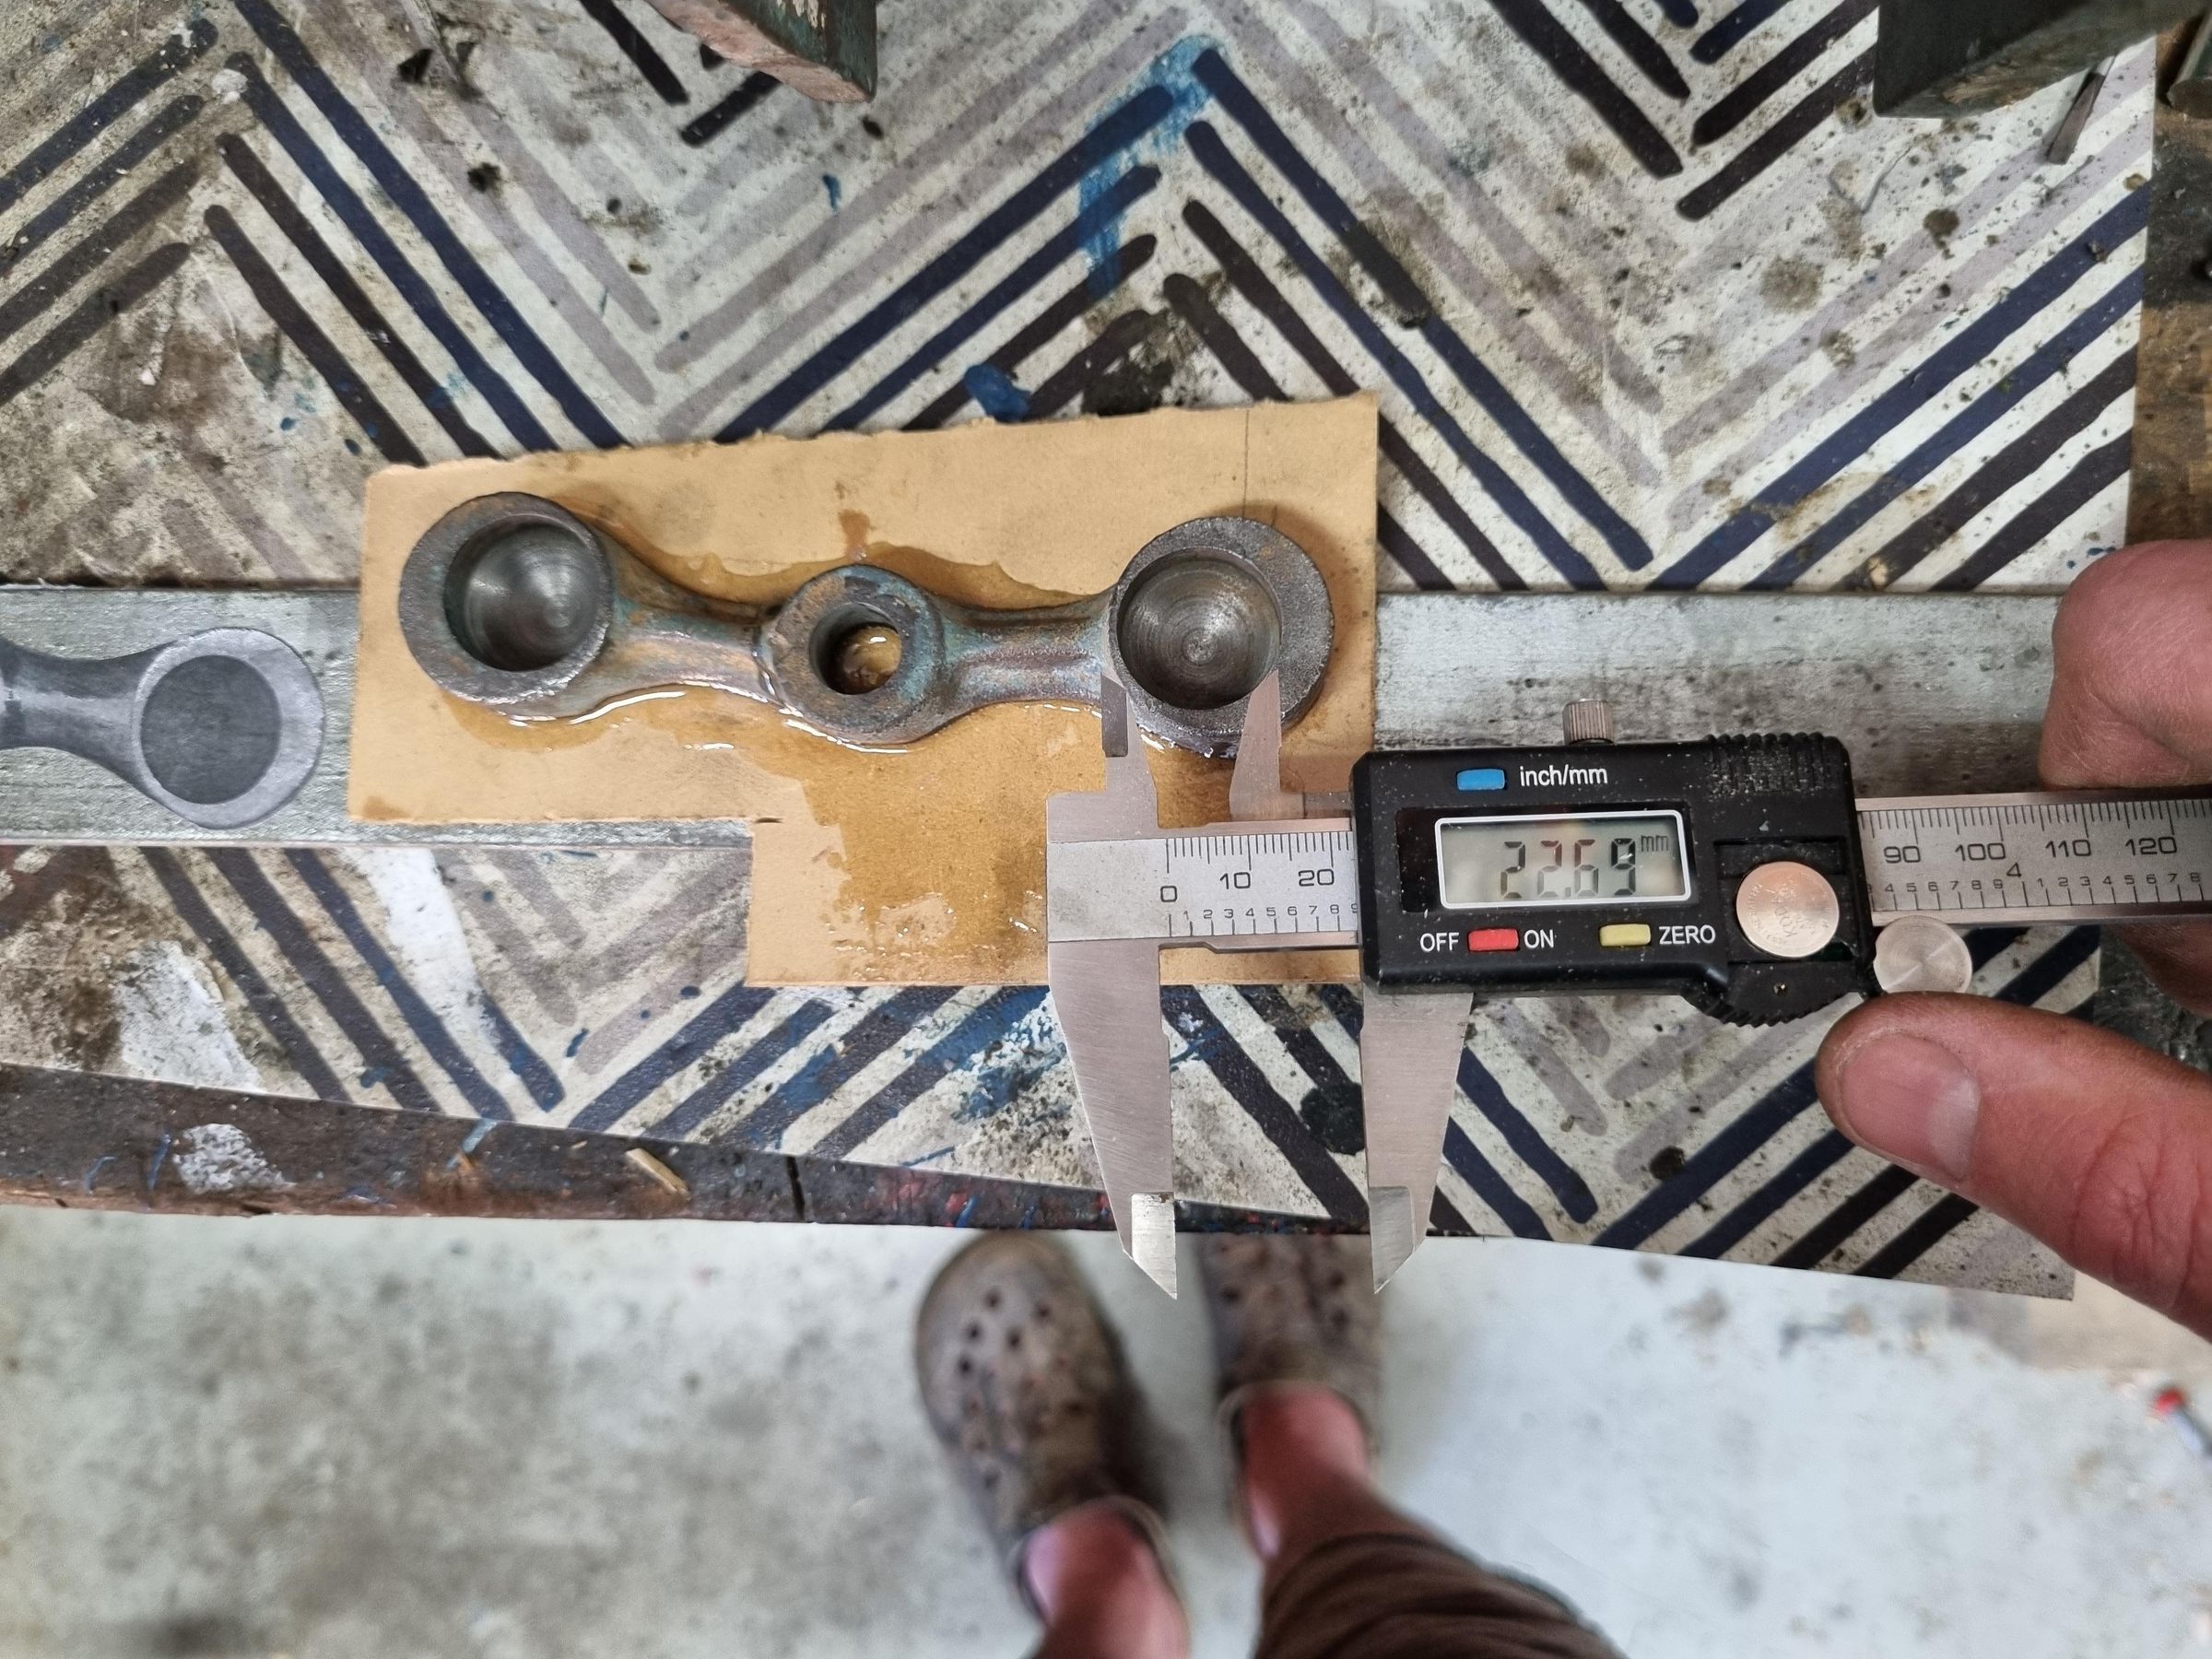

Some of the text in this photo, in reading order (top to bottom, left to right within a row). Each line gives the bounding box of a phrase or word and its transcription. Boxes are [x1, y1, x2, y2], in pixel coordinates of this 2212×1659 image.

[1520, 764, 1608, 787] inch/mm
[1640, 834, 1670, 853] mm
[1883, 836, 2178, 864] 90 100 110 120
[1159, 868, 1335, 903] 0 10 20
[1884, 883, 1894, 893] 4
[1906, 882, 1917, 893] 5
[1927, 881, 1939, 892] 6
[1949, 880, 1959, 890] 7
[1971, 879, 1983, 891] 8
[1993, 878, 2004, 890] 9
[2006, 862, 2023, 878] 4
[2036, 872, 2202, 888] 1 2 3 4 5 6 7 8
[1182, 910, 1189, 921] 1
[1203, 909, 1213, 919] 2
[1224, 908, 1234, 919] 3
[1245, 907, 1255, 918] 4
[1265, 907, 1277, 917] 5
[1287, 906, 1298, 916] 6
[1308, 905, 1318, 915] 7
[1329, 904, 1340, 914] 8
[1419, 929, 1555, 952] OFF ON
[1658, 924, 1716, 946] ZERO
